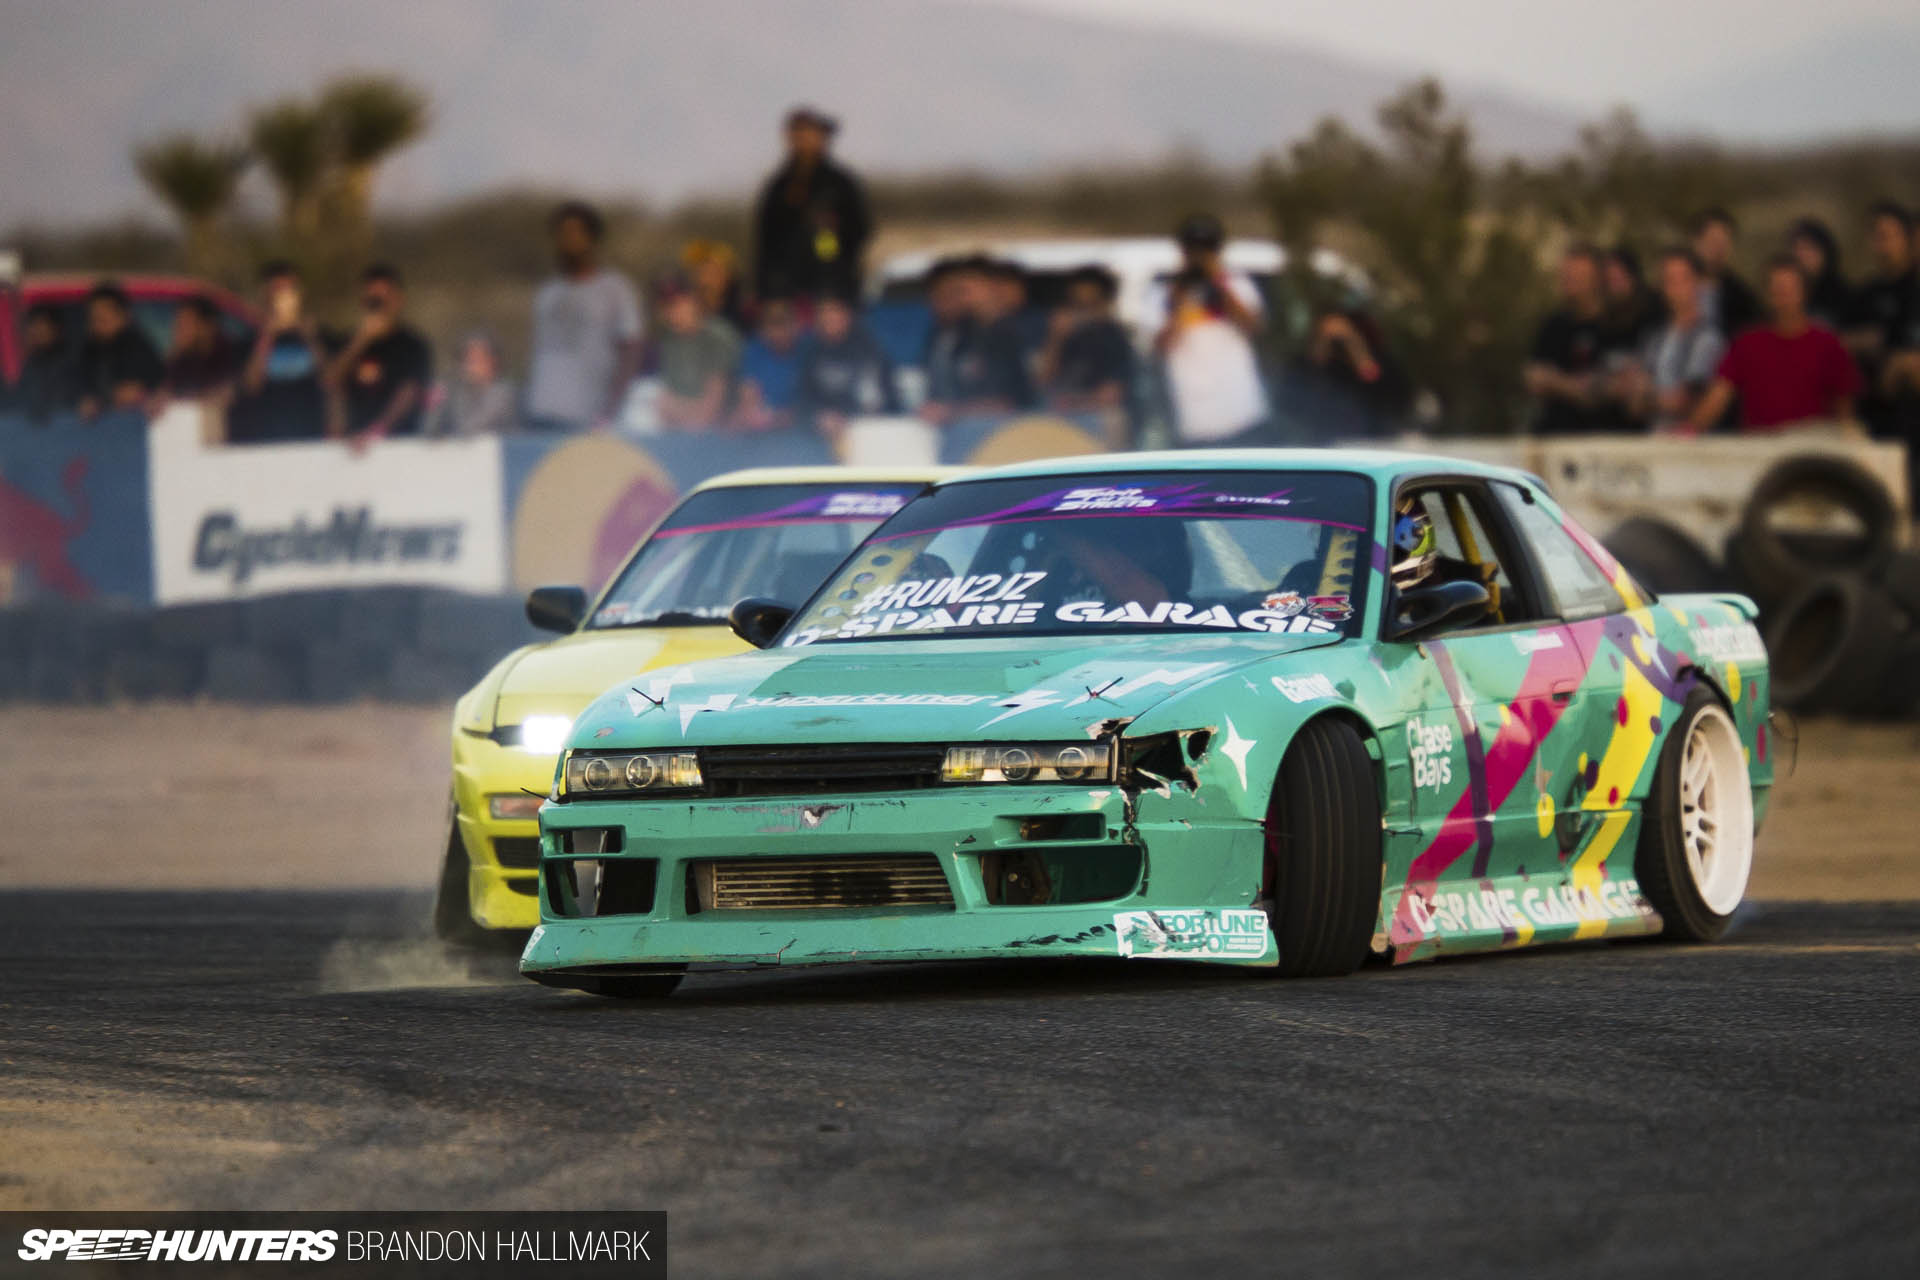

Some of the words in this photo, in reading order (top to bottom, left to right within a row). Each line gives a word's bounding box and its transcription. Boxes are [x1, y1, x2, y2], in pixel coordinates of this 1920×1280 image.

[852, 571, 1048, 615] #RUN2JZ
[1055, 601, 1335, 633] GARAGE
[1406, 716, 1452, 754] Chase
[1411, 746, 1452, 794] Bays
[1159, 914, 1265, 933] FORTUNE
